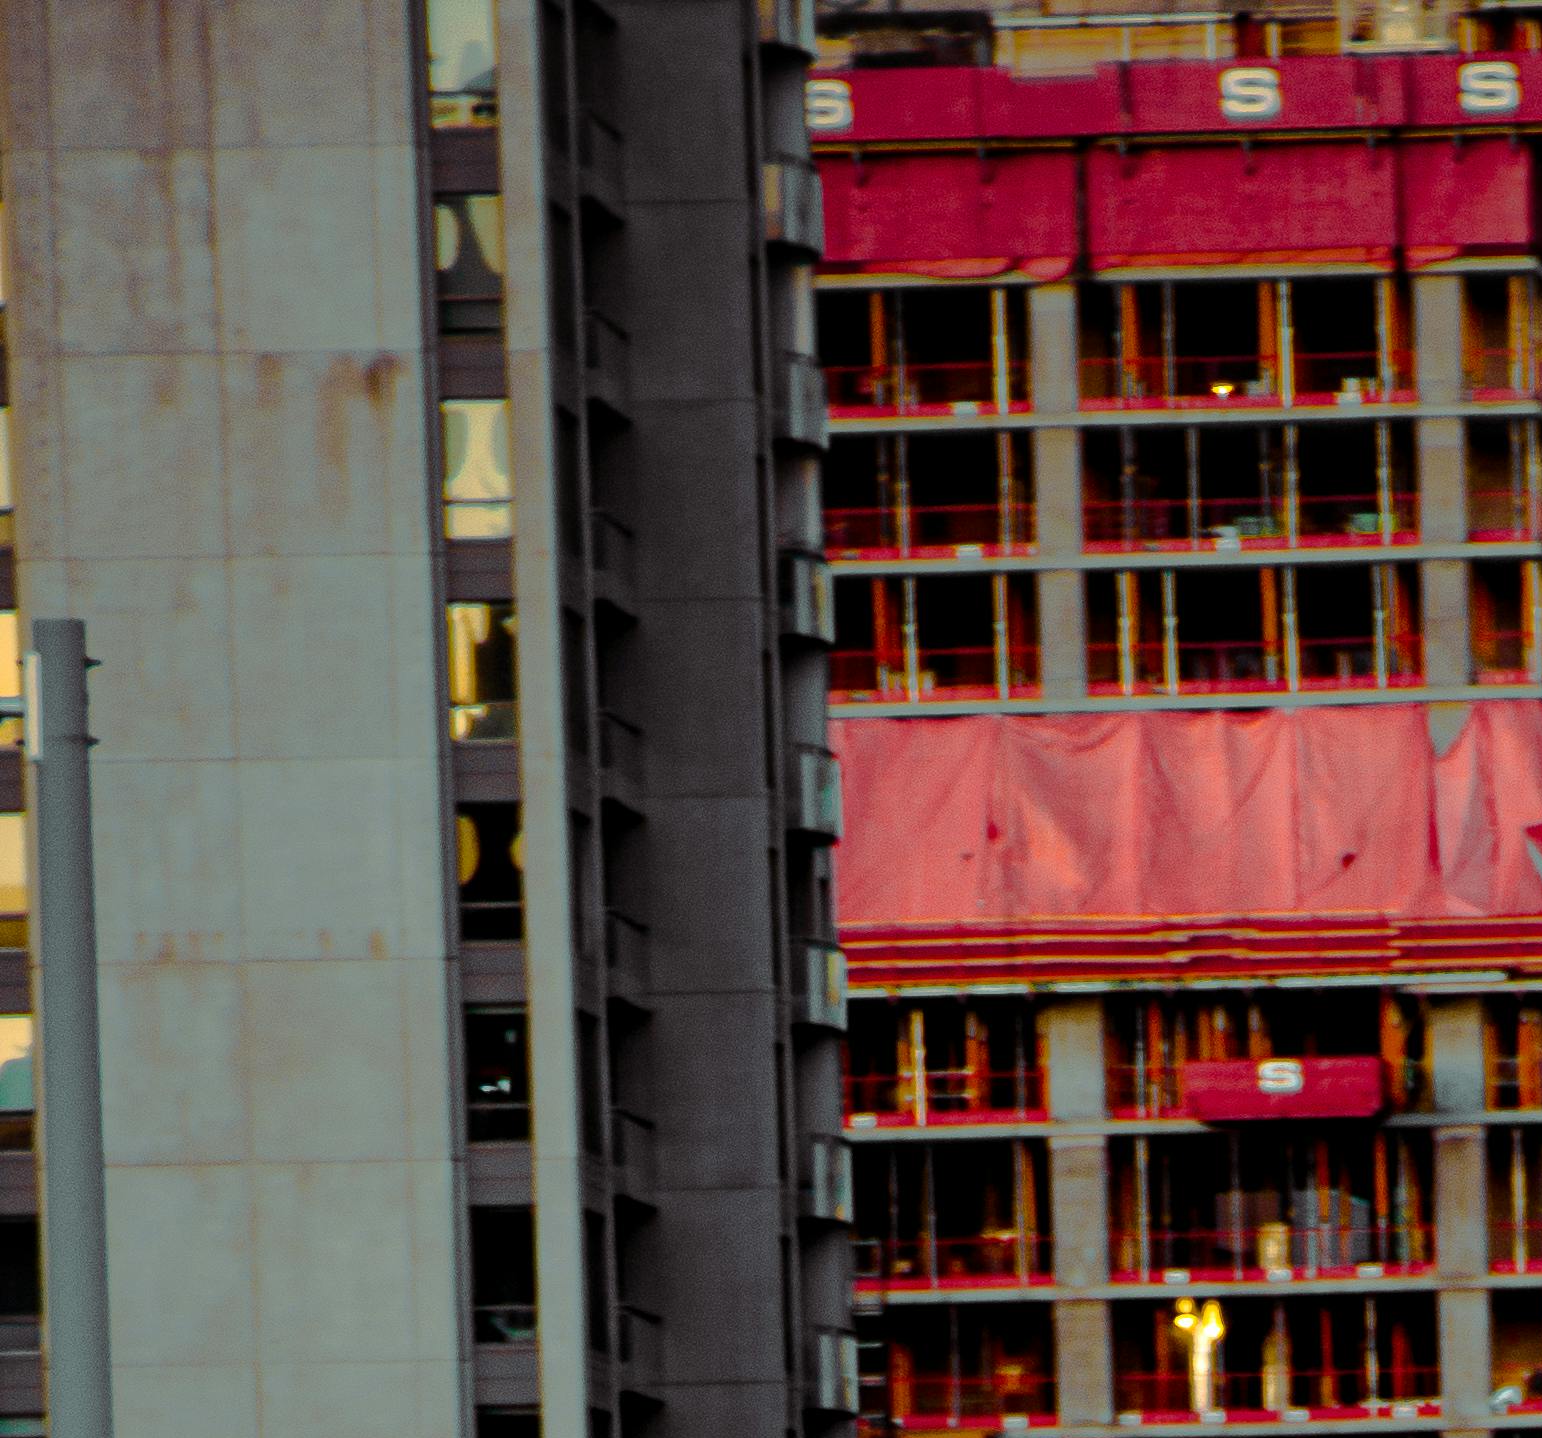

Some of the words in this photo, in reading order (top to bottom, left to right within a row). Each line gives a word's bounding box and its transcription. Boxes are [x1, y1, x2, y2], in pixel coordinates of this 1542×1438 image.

[1220, 67, 1282, 119] S
[1458, 61, 1522, 112] S
[1257, 1060, 1303, 1094] S
